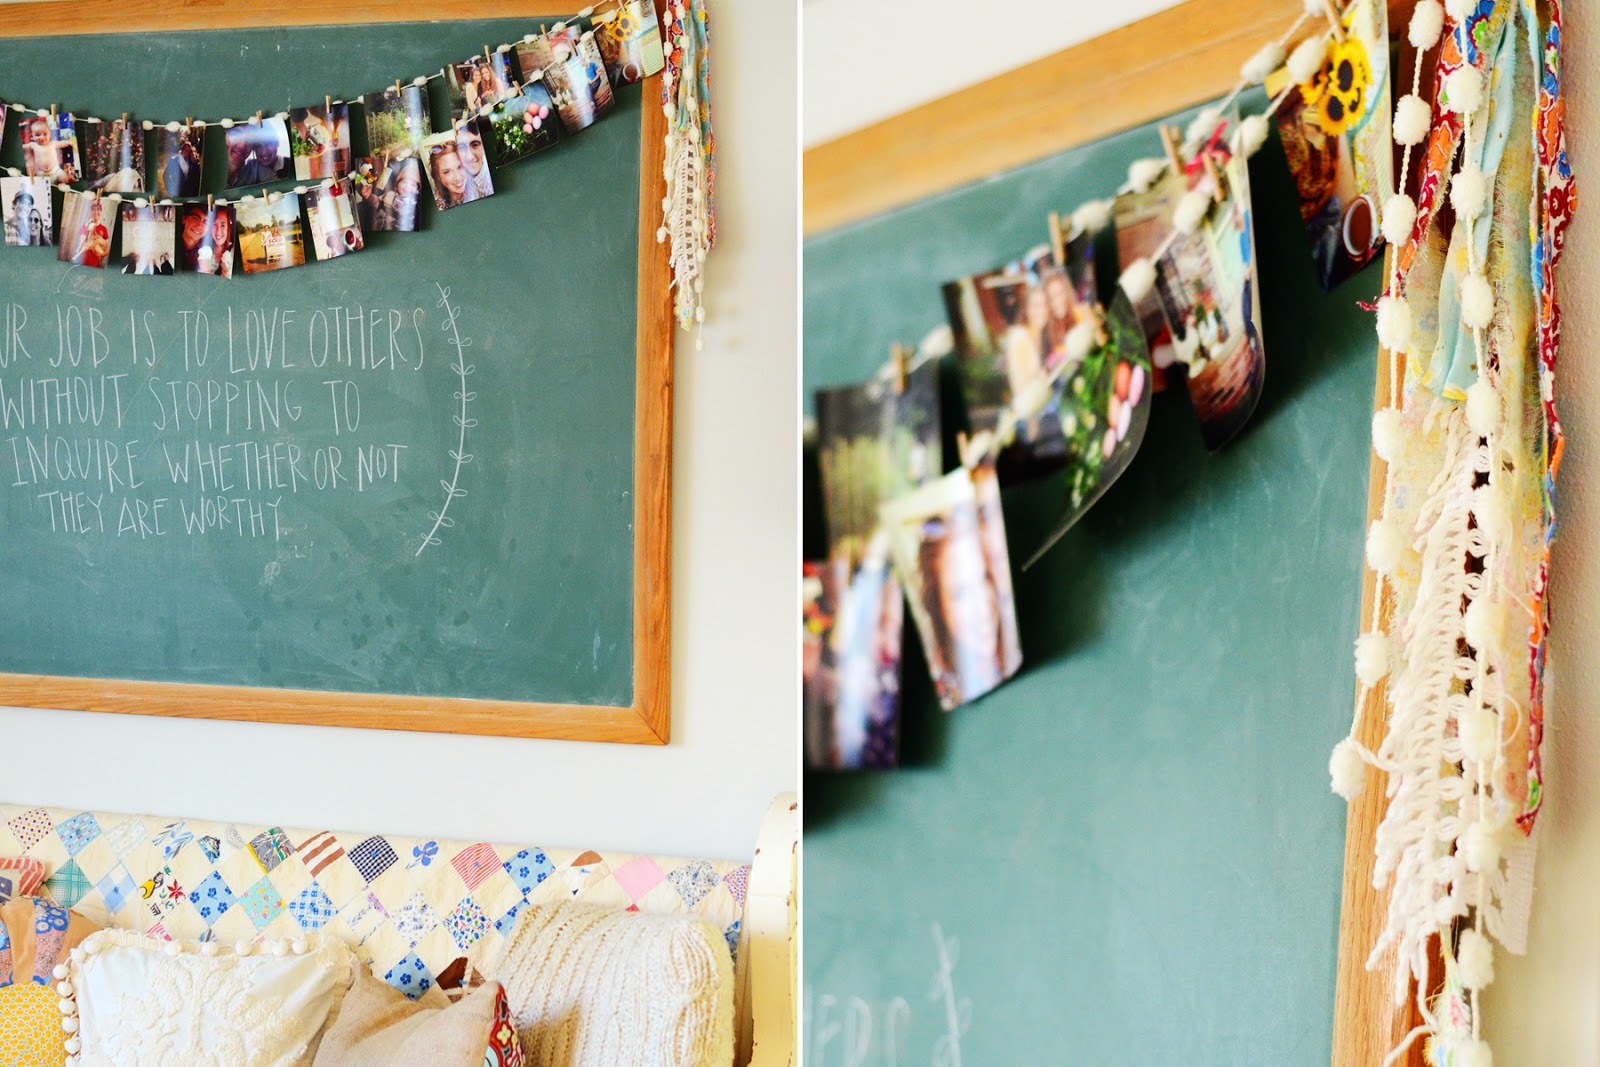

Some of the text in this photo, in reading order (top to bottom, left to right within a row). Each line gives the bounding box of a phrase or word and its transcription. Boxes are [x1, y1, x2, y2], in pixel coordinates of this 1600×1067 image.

[49, 303, 110, 369] JOB
[130, 308, 156, 367] IS
[177, 310, 209, 371] TO
[228, 306, 296, 374] LOVE
[310, 304, 424, 371] OTHERS
[0, 374, 360, 436] WITHOUT STOPPING TO
[5, 433, 409, 494] INQUIRE WHETHER OR NOT
[37, 490, 282, 542] THEY ARE WORTHY
